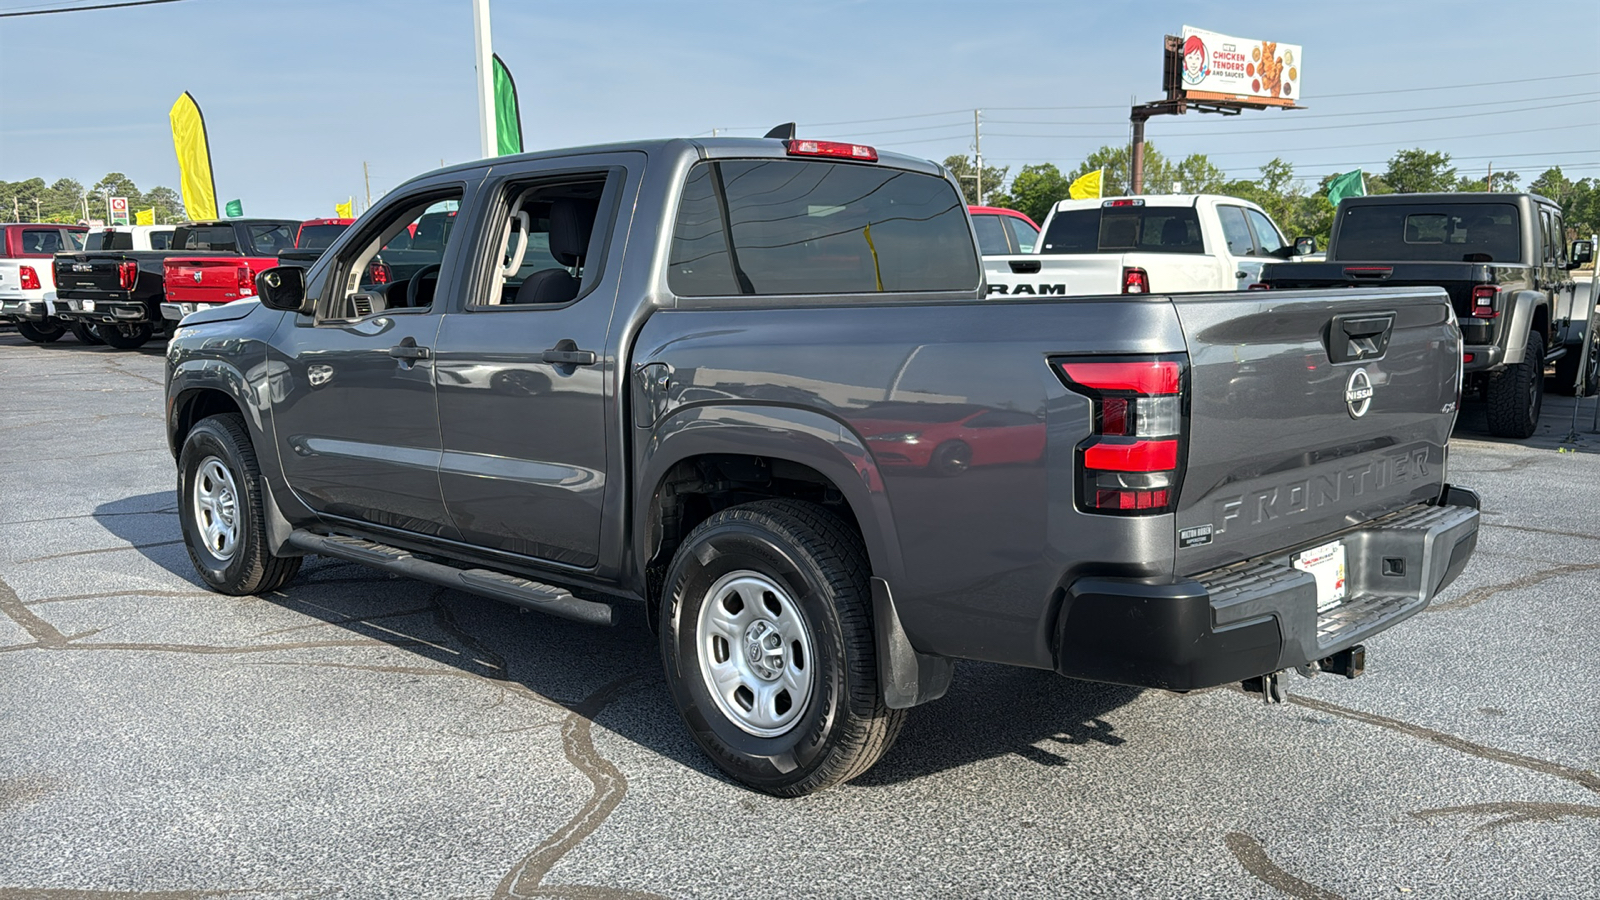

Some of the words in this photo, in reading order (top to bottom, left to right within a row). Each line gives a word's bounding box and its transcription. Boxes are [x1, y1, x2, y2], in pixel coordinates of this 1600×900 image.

[1213, 51, 1245, 62] CHICKEN
[1212, 60, 1245, 72] TENDERS
[1224, 71, 1245, 79] SAUCES
[987, 284, 1066, 295] RAM
[1213, 446, 1430, 534] FRONTIER
